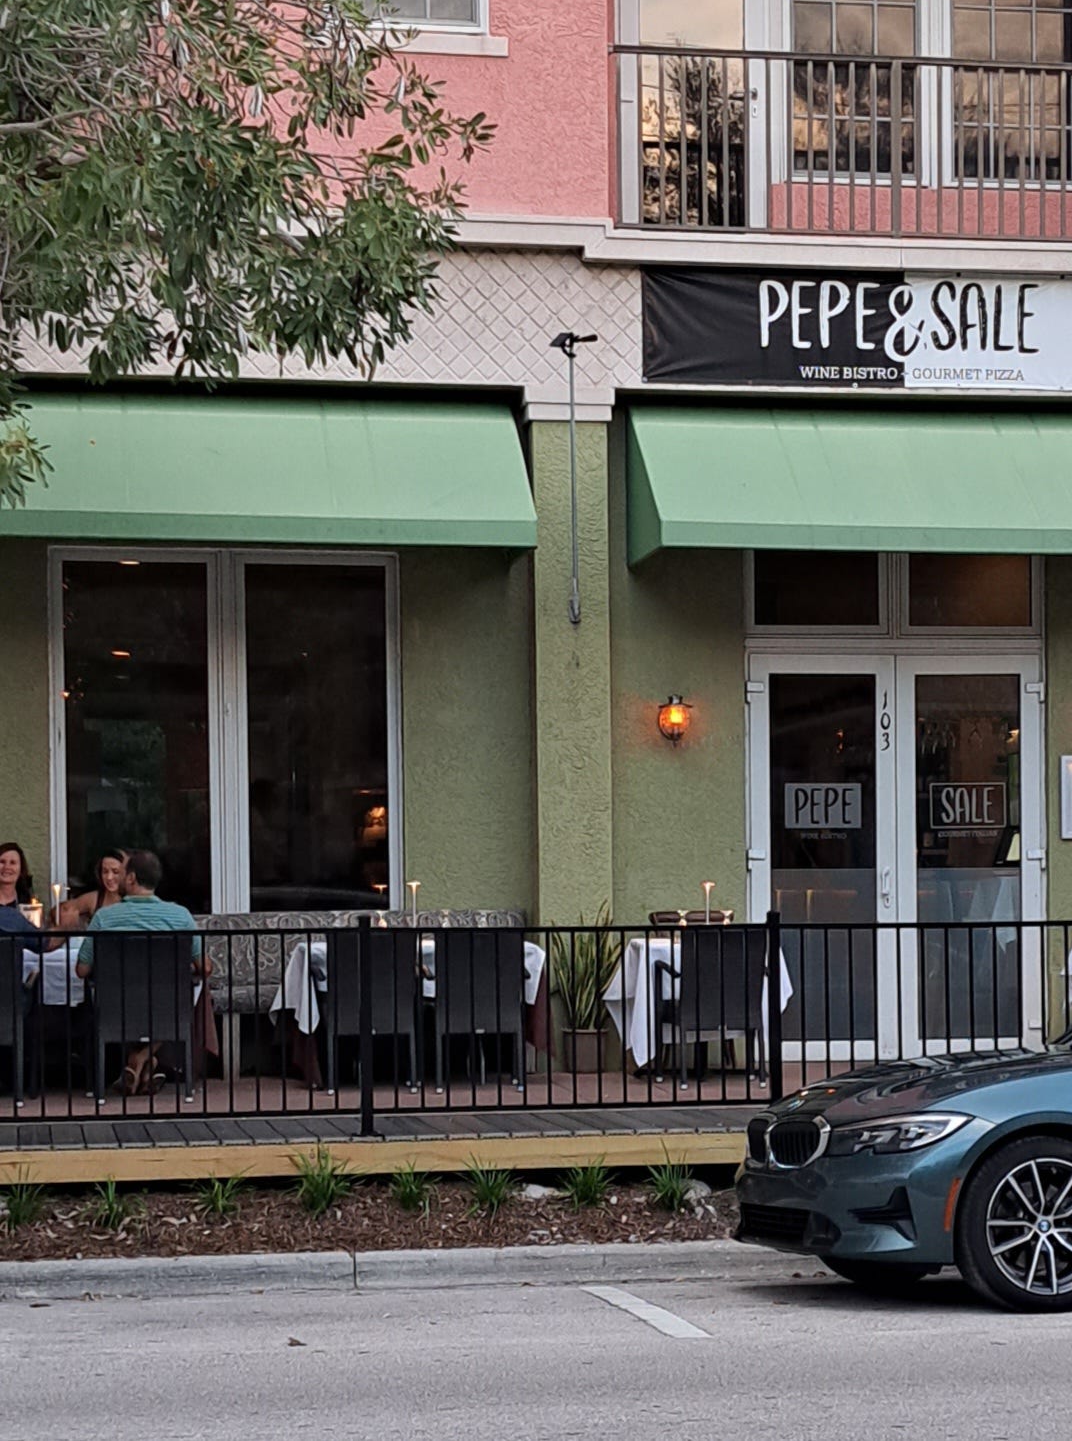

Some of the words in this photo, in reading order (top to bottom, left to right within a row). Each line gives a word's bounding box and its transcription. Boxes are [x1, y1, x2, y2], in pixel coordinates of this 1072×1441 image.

[759, 279, 879, 349] PEPE
[884, 282, 928, 363] &
[930, 280, 1040, 353] SALE
[800, 366, 840, 379] WINE
[842, 367, 898, 379] BISTRO
[912, 367, 982, 380] GOURMET
[985, 369, 1025, 381] PIZZA
[880, 688, 891, 752] 103
[794, 787, 855, 825] PEPE
[941, 786, 996, 824] SALE
